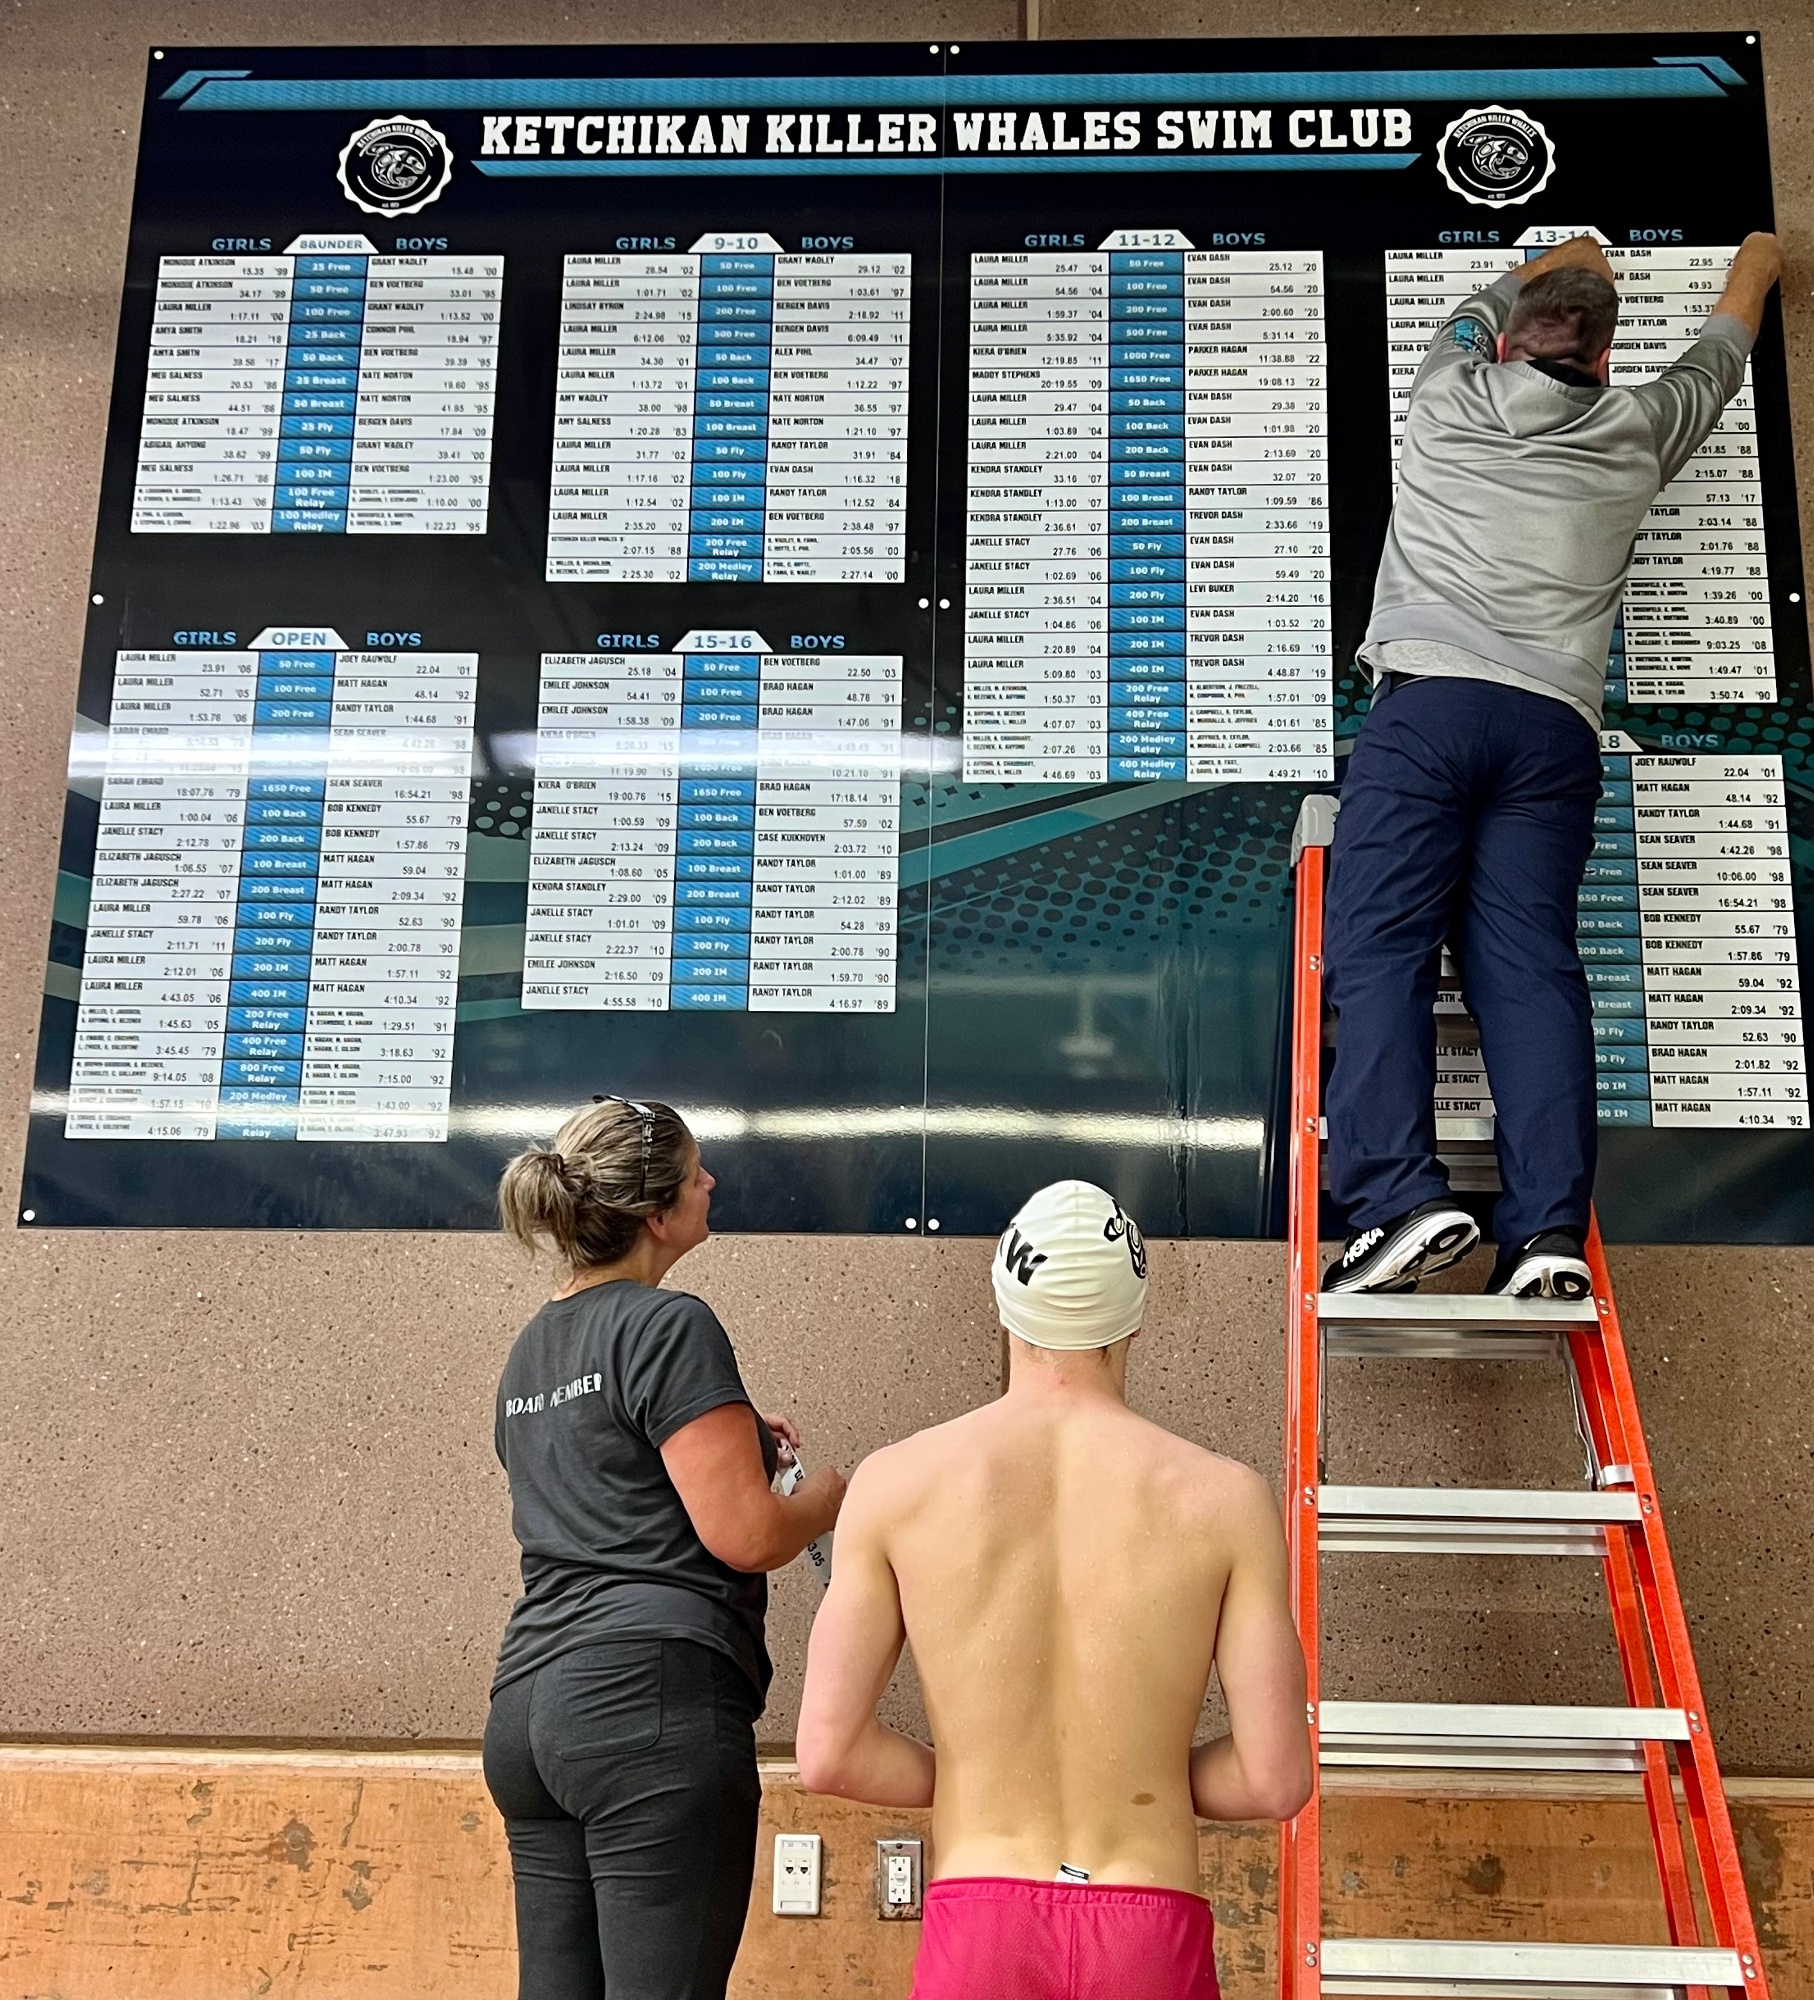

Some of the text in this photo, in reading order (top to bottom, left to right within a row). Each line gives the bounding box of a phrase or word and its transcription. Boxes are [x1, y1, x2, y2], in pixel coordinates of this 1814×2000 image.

[480, 108, 1412, 155] KETCHIKAN KILLER WHALES SWIM CLUB
[1452, 114, 1538, 139] KETCHIKAN KILLER WHALES
[1024, 234, 1085, 247] GIRLS
[1119, 233, 1176, 247] 11-12
[1212, 232, 1266, 245] BOYS
[1438, 230, 1500, 243] GIRLS
[1629, 228, 1683, 242] BOYS
[211, 238, 272, 251] GIRLS
[299, 239, 363, 249] 8&UNDER
[396, 237, 448, 250] BOYS
[615, 237, 676, 250] GIRLS
[714, 237, 759, 250] 9-10
[801, 236, 854, 249] BOYS
[1387, 251, 1444, 260] LAURA MILLER
[1604, 249, 1652, 258] EVAN DASH
[1470, 260, 1494, 270] 23.91
[1689, 257, 1714, 267] 22.95
[158, 303, 212, 312] LAURA MILLER
[1188, 345, 1248, 354] PARKER HAGAN
[294, 399, 345, 408] 50 Breast
[360, 394, 411, 403] NATE NORTON
[558, 417, 612, 426] AMY SALNESS
[771, 441, 829, 450] RANDY TAYLOR
[712, 494, 745, 502] 100 IM
[969, 513, 1043, 522] KENDRA STANDLEY
[1189, 511, 1243, 520] TREVOR DASH
[1649, 507, 1681, 517] TAYLOR
[1044, 522, 1102, 532] 2:36.61 '07
[1121, 518, 1173, 526] 200 Breast
[1265, 520, 1323, 530] 2:33.66 '19
[1698, 517, 1758, 527] 2:03.14 '88
[969, 562, 1030, 571] JANELLE STACY
[1045, 571, 1102, 581] 1:02.69 '06
[1189, 584, 1235, 593] LEVI BUKER
[1266, 593, 1325, 603] 2:14.20 '16
[1190, 609, 1235, 618] EVAN DASH
[1267, 618, 1325, 629] 1:03.52 '20
[1705, 615, 1765, 626] 3:40.89 '00
[173, 631, 237, 645] GIRLS
[271, 632, 326, 646] OPEN
[366, 632, 422, 647] BOYS
[596, 634, 660, 648] GIRLS
[694, 635, 752, 649] 15-16
[790, 635, 845, 649] BOYS
[968, 635, 1024, 644] LAURA MILLER
[1043, 644, 1102, 655] 2:20.89 '04
[544, 656, 626, 665] ELIZABETH JAGUSCH
[627, 667, 677, 677] 25.18 '04
[1129, 665, 1165, 673] 400 IM
[1708, 665, 1768, 676] 1:49.47 '01
[1661, 735, 1719, 748] BOYS
[1634, 757, 1697, 767] JOEY RAUWOLF
[1268, 769, 1328, 779] 4:49.21 '10
[1723, 767, 1776, 778] 22.04 '01
[693, 788, 742, 797] 1650 Free
[1637, 808, 1701, 818] RANDY TAYLOR
[1718, 819, 1780, 830] 1:44.68 '91
[253, 860, 307, 869] 100 Breast
[756, 858, 816, 868] RANDY TAYLOR
[834, 869, 892, 880] 1:01.00 '89
[321, 880, 373, 889] MATT HAGAN
[532, 882, 607, 892] KENDRA STANDLEY
[391, 891, 457, 902] 2:09.34 '92
[608, 893, 667, 904] 2:29.00 '09
[693, 941, 730, 952] 200 Fly
[1645, 939, 1703, 950] BOB KENNEDY
[87, 953, 146, 965] LAURA MILLER
[1727, 951, 1791, 962] 1:57.86 '79
[527, 959, 596, 969] EMILEE JOHNSON
[163, 967, 224, 978] 2:12.01 '06
[604, 971, 664, 982] 2:16.50 '09
[1651, 1047, 1708, 1058] BRAD HAGAN
[1734, 1059, 1799, 1071] 2:01.82 '92
[1654, 1102, 1711, 1113] MATT HAGAN
[1738, 1114, 1803, 1126] 4:10.34 '92
[1342, 1227, 1385, 1268] HOKA
